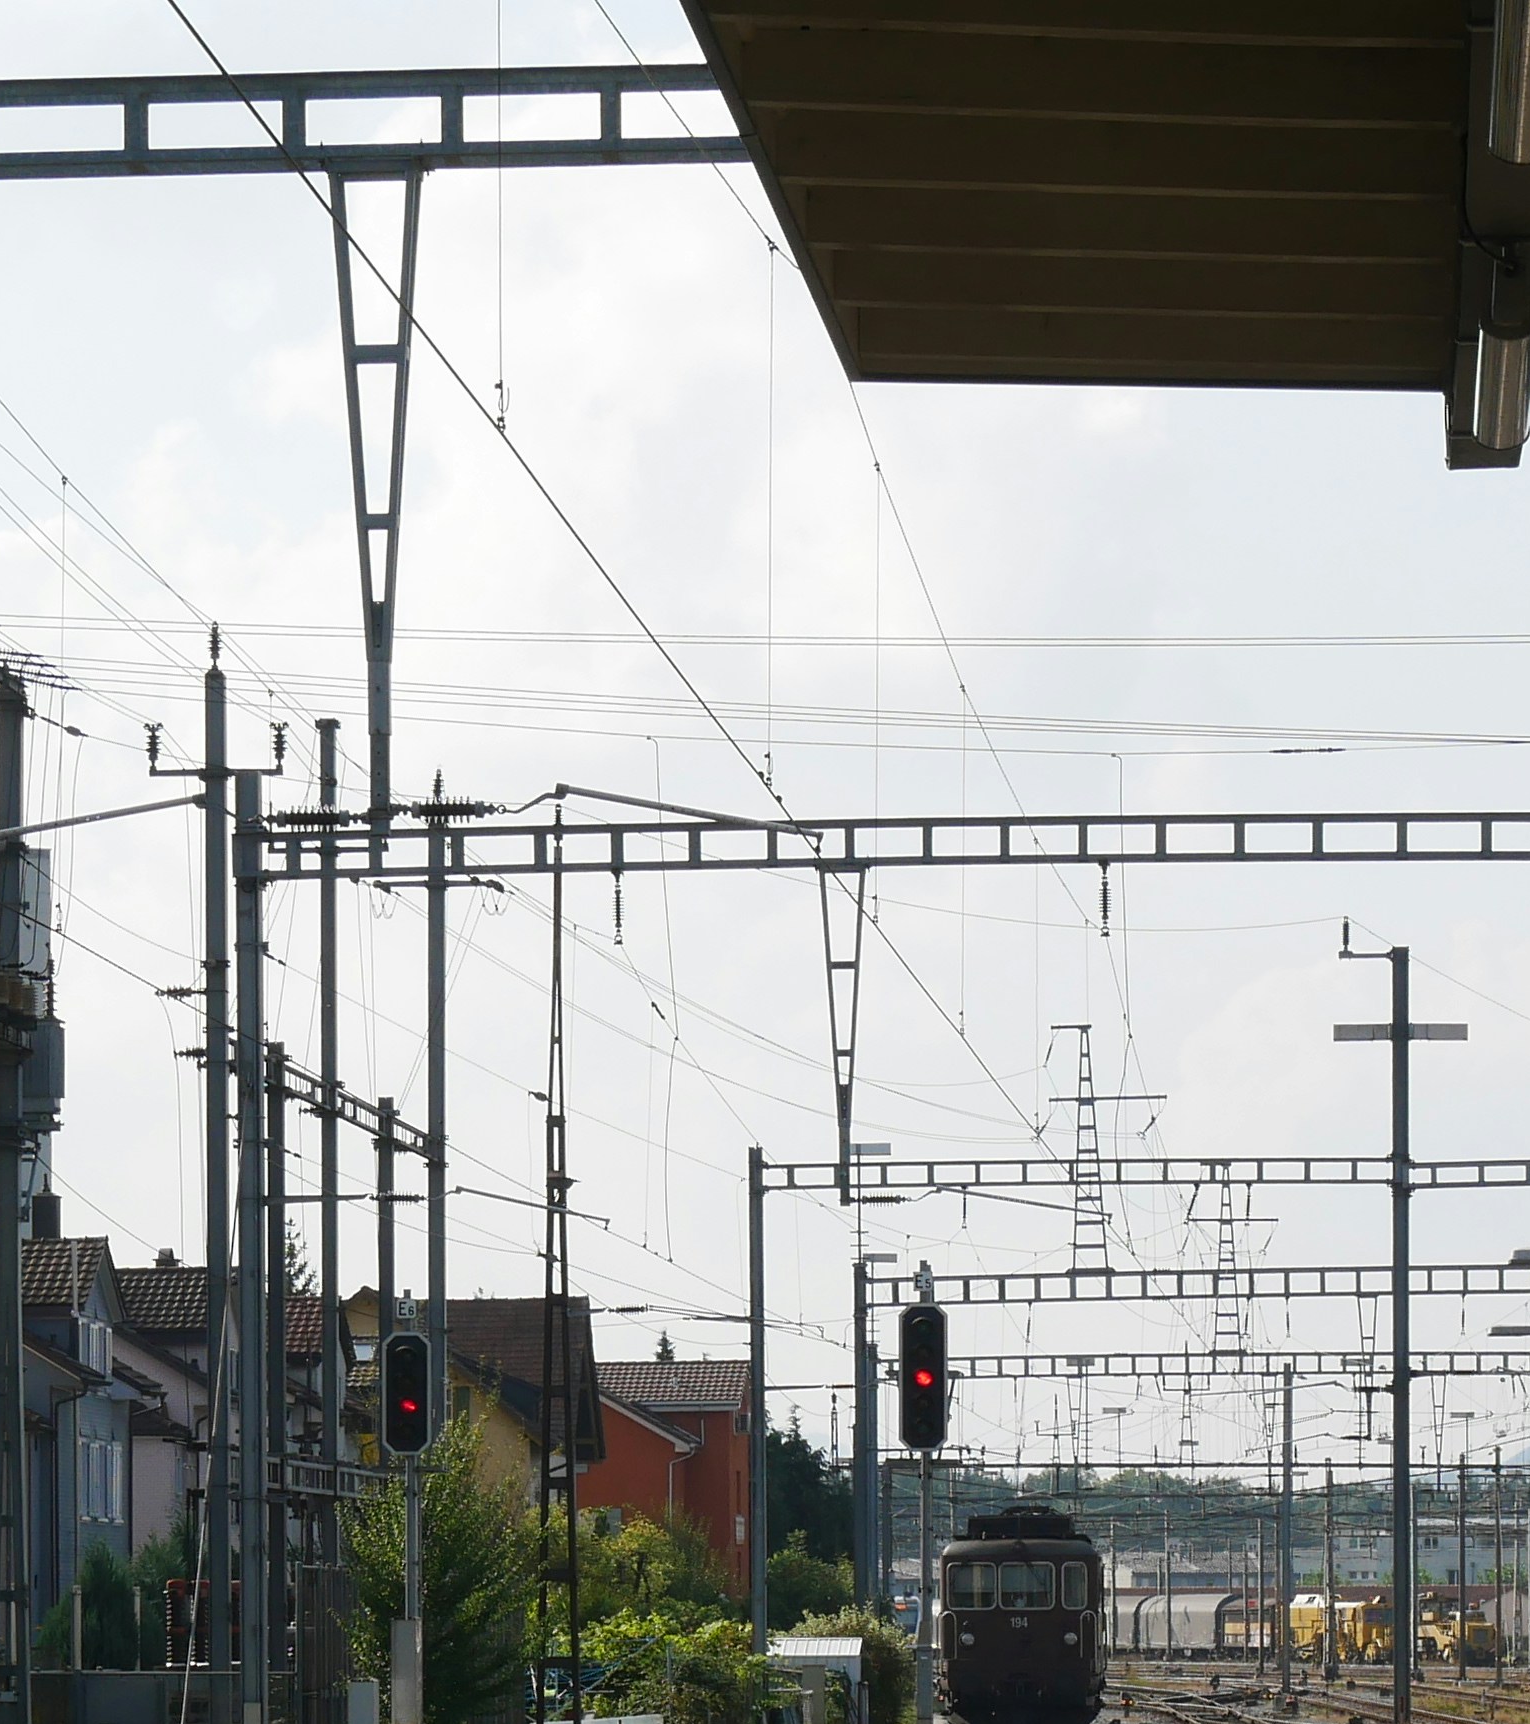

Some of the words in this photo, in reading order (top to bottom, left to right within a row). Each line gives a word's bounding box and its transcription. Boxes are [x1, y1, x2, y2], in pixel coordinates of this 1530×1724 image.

[915, 1274, 931, 1288] E5
[398, 1301, 414, 1316] E6
[1009, 1616, 1028, 1628] 194
